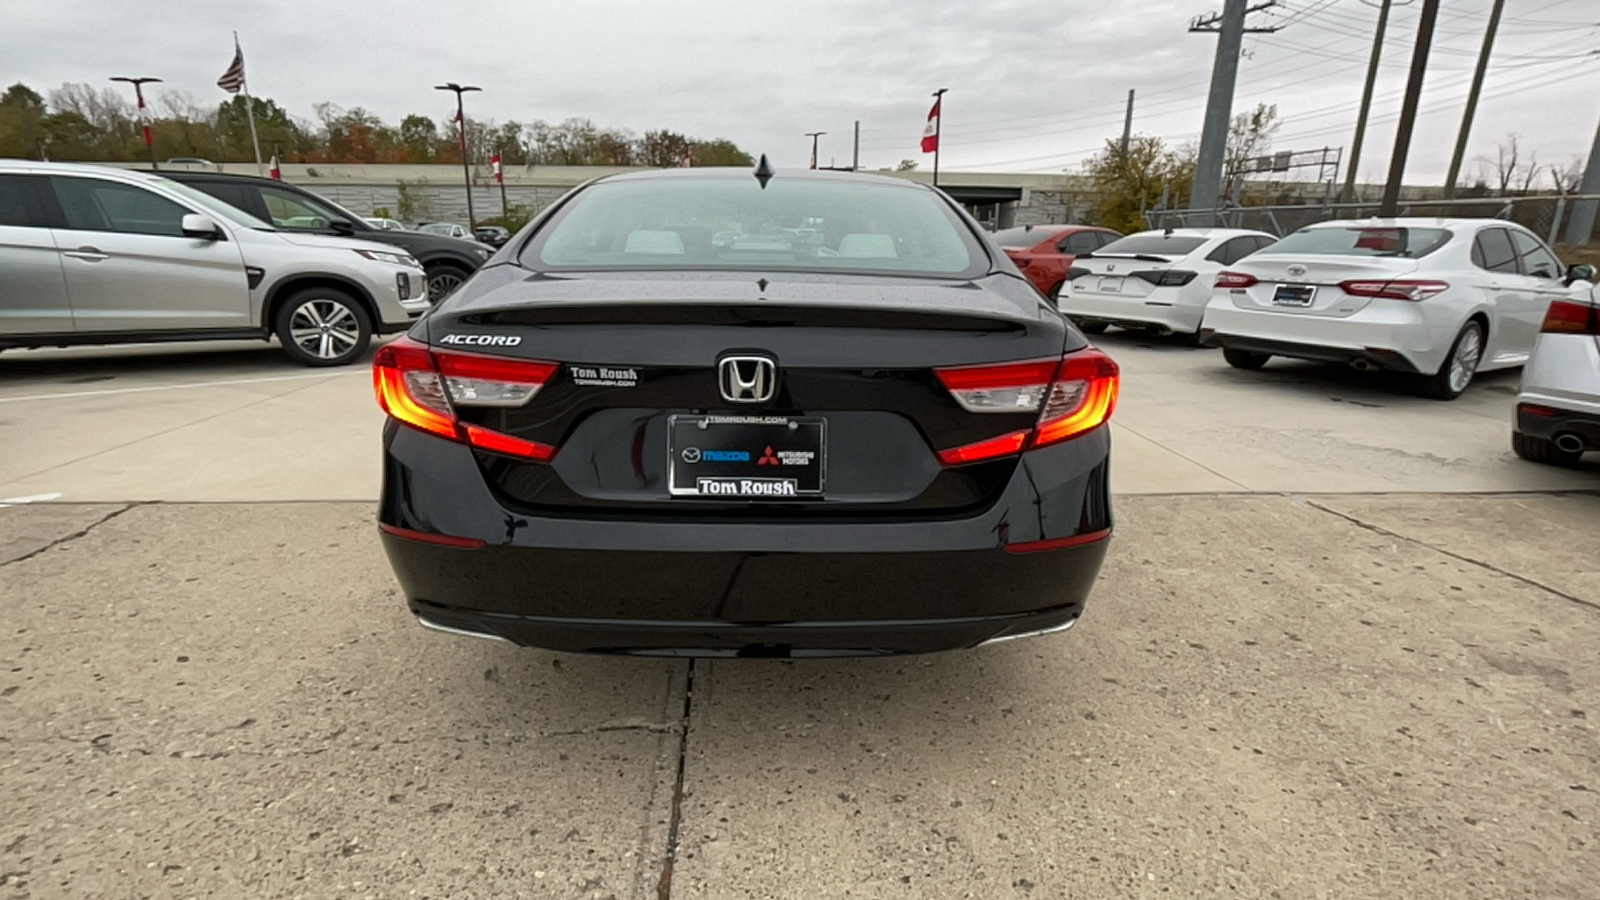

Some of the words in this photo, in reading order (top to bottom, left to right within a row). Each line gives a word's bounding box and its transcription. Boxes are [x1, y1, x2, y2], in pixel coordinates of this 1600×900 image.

[440, 334, 521, 346] ACCORD
[571, 367, 597, 378] Tom
[600, 369, 637, 380] Roush
[699, 480, 736, 494] Tom
[740, 480, 795, 495] Roush
